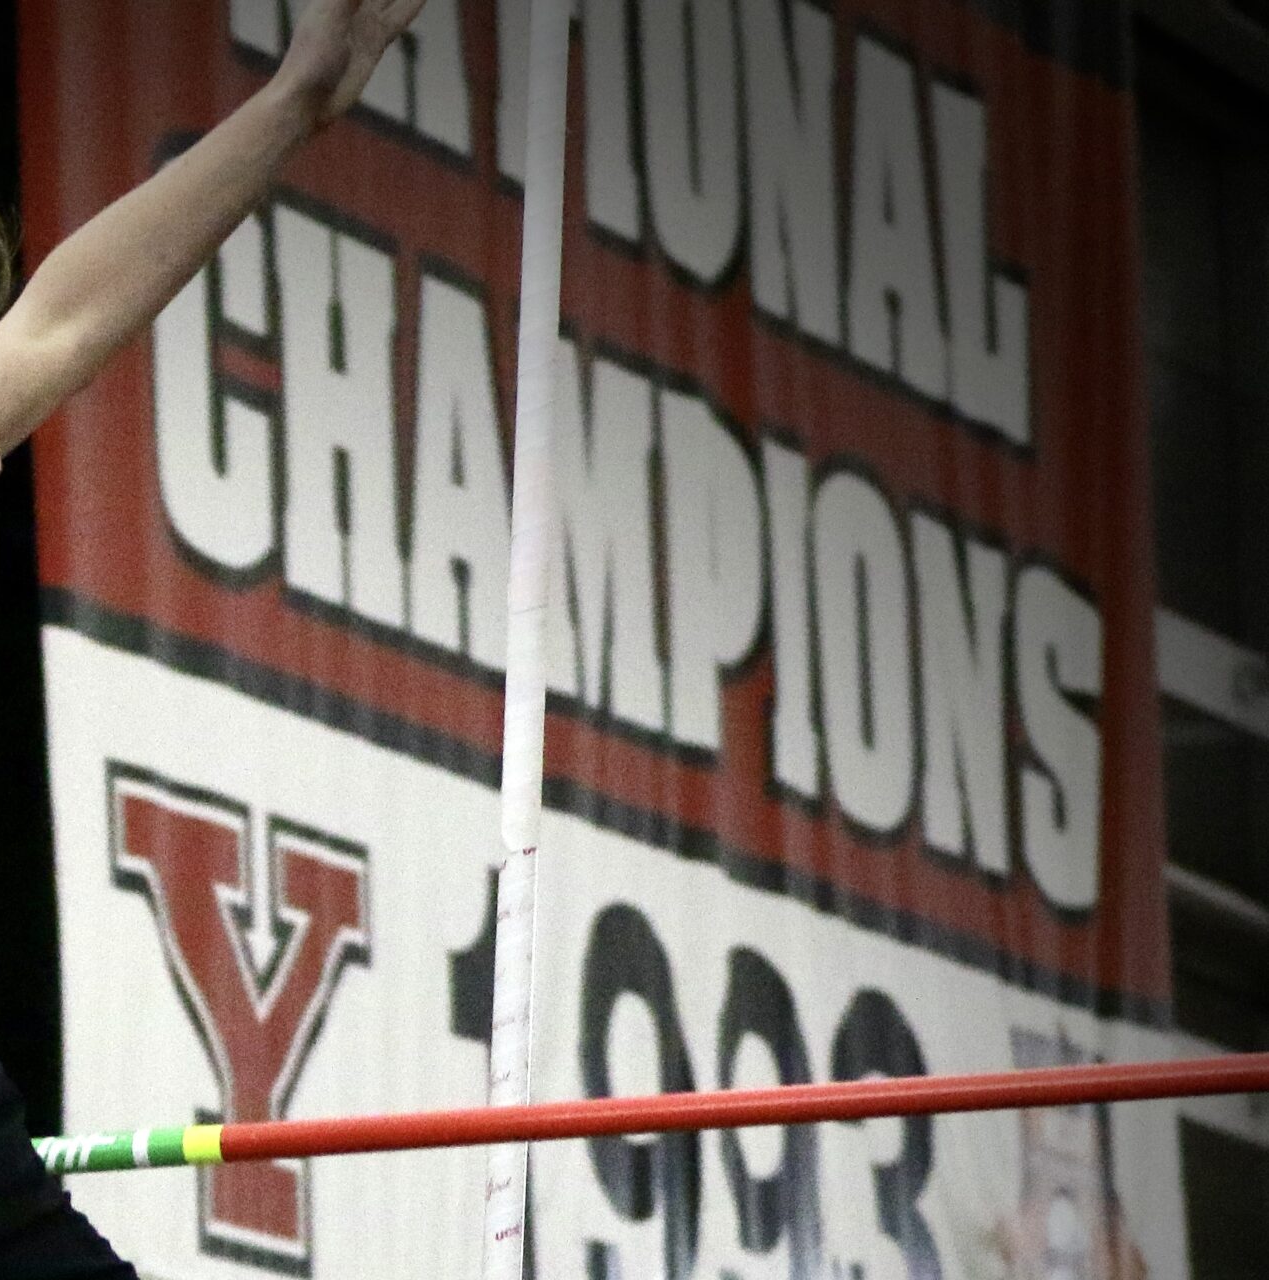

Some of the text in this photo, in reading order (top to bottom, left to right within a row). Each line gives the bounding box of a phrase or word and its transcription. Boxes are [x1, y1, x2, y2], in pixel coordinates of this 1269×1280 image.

[229, 0, 1031, 447] IONAL
[151, 200, 1103, 910] CHAMPIONS
[105, 758, 373, 1280] Y
